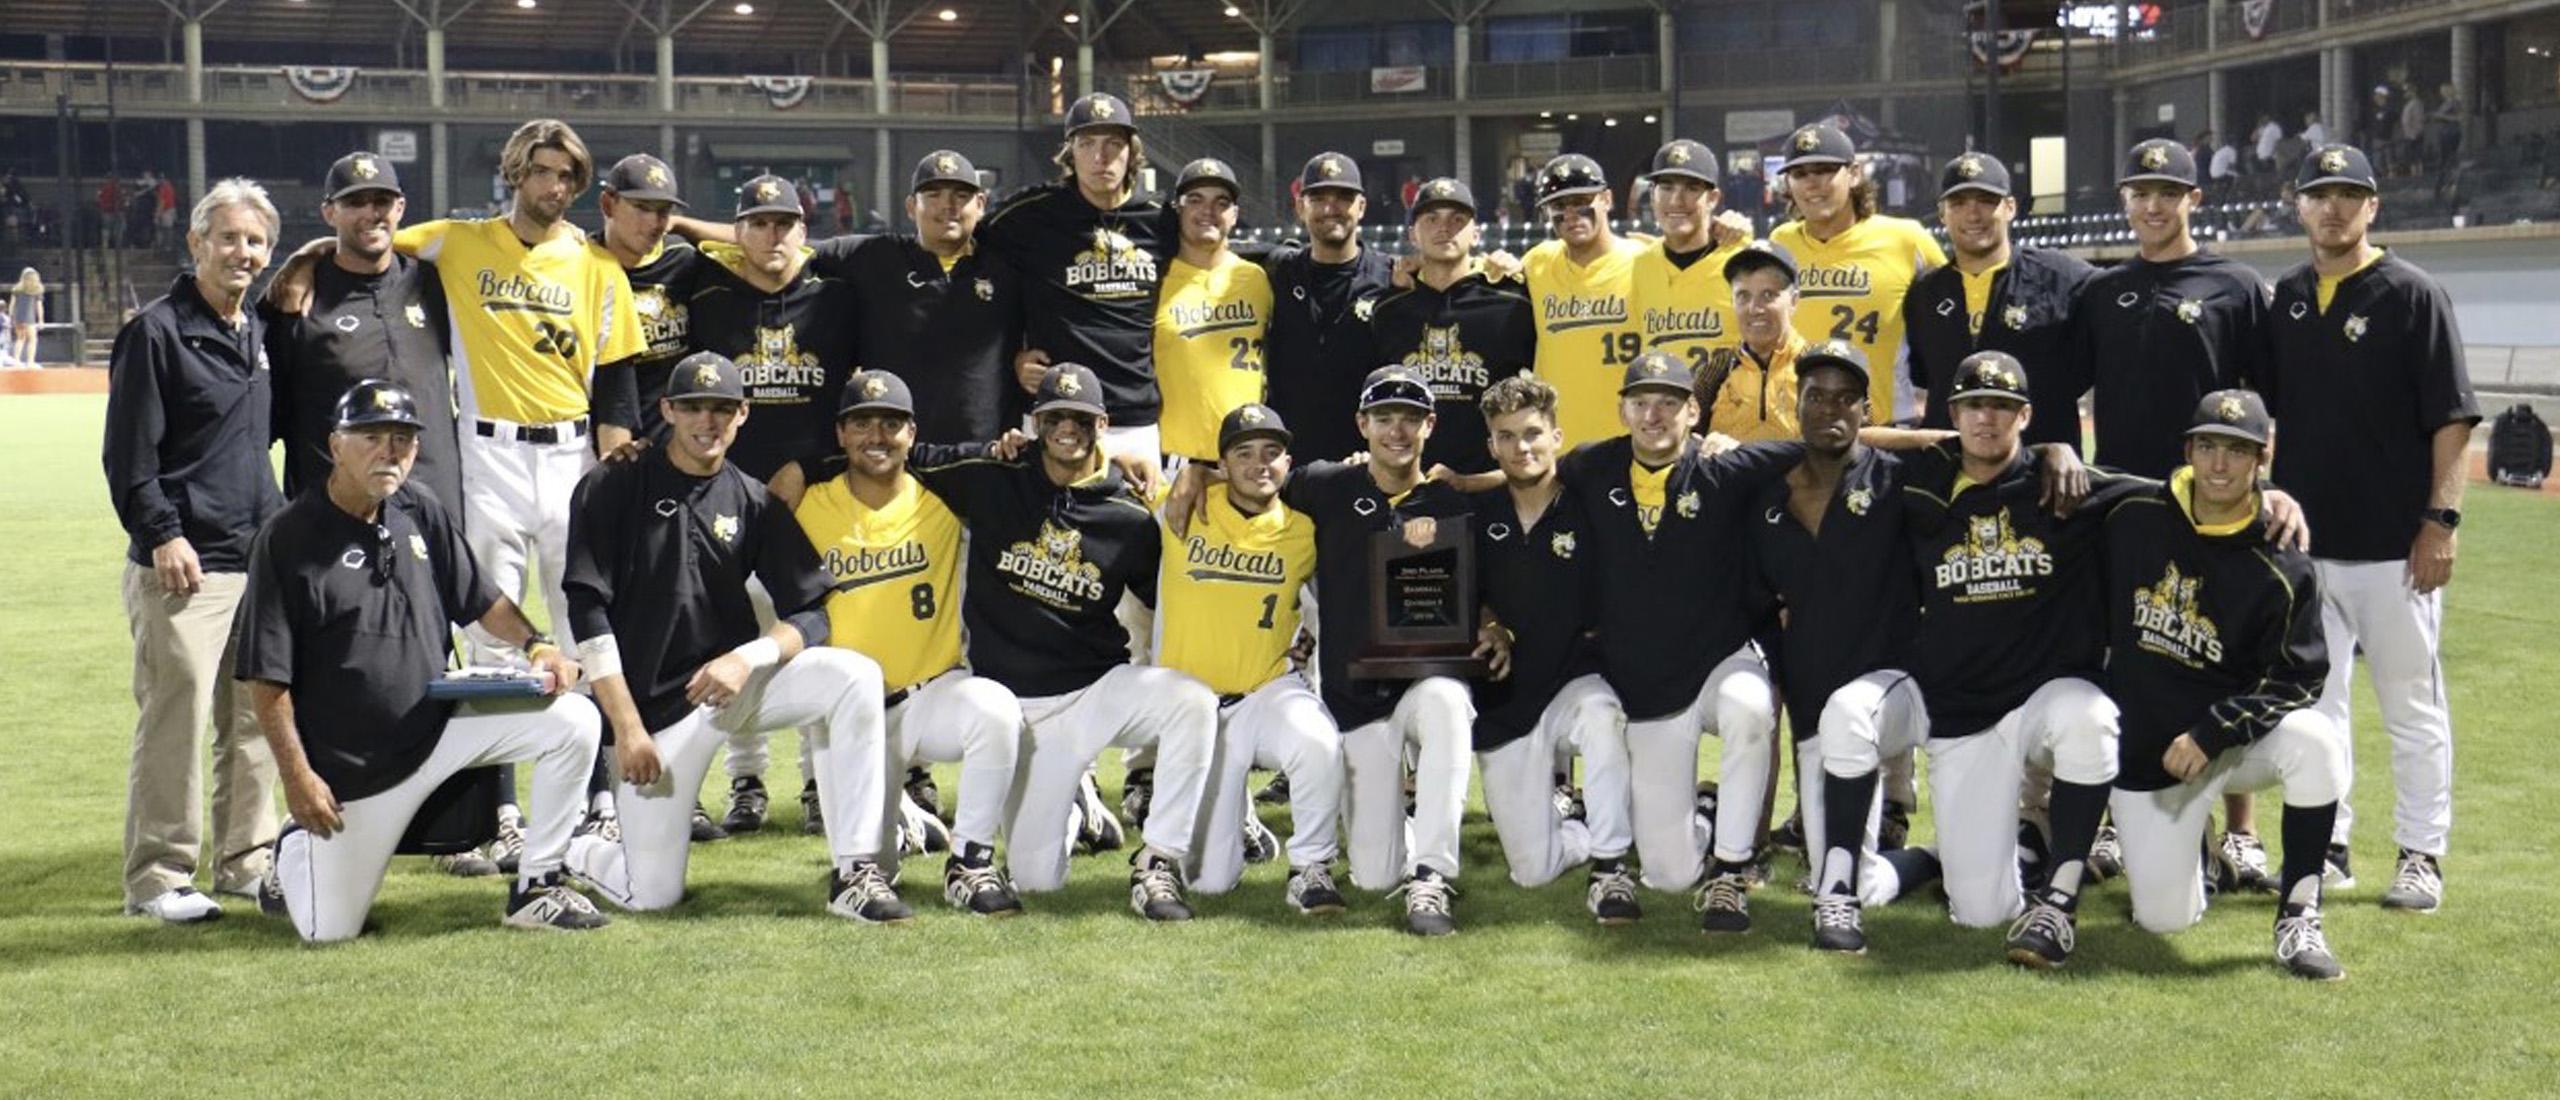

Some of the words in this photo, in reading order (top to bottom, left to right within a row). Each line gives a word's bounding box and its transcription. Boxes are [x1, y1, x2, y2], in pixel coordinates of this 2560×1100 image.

[477, 269, 571, 308] Bobcats
[1065, 261, 1157, 287] BOBCATS
[1798, 264, 1868, 289] obcats
[1169, 299, 1254, 326] Bobcats
[1543, 295, 1626, 320] Bobcats
[1644, 307, 1720, 334] Bobcats
[1829, 304, 1879, 344] 24
[534, 321, 576, 360] 20
[1230, 336, 1264, 371] 23
[1601, 332, 1642, 365] 19
[740, 365, 825, 387] OBCATS
[753, 386, 799, 398] BASEBALL
[826, 541, 926, 578] Bobcats
[1187, 536, 1284, 576] Bobcats
[1935, 553, 2053, 588] BOBCATS
[997, 550, 1105, 601] BOBCATS
[1023, 579, 1069, 603] BASEBALL
[1966, 579, 2021, 595] BASEBALL
[911, 582, 936, 620] 8
[1257, 593, 1278, 629] 1
[2133, 604, 2223, 663] OBCATS
